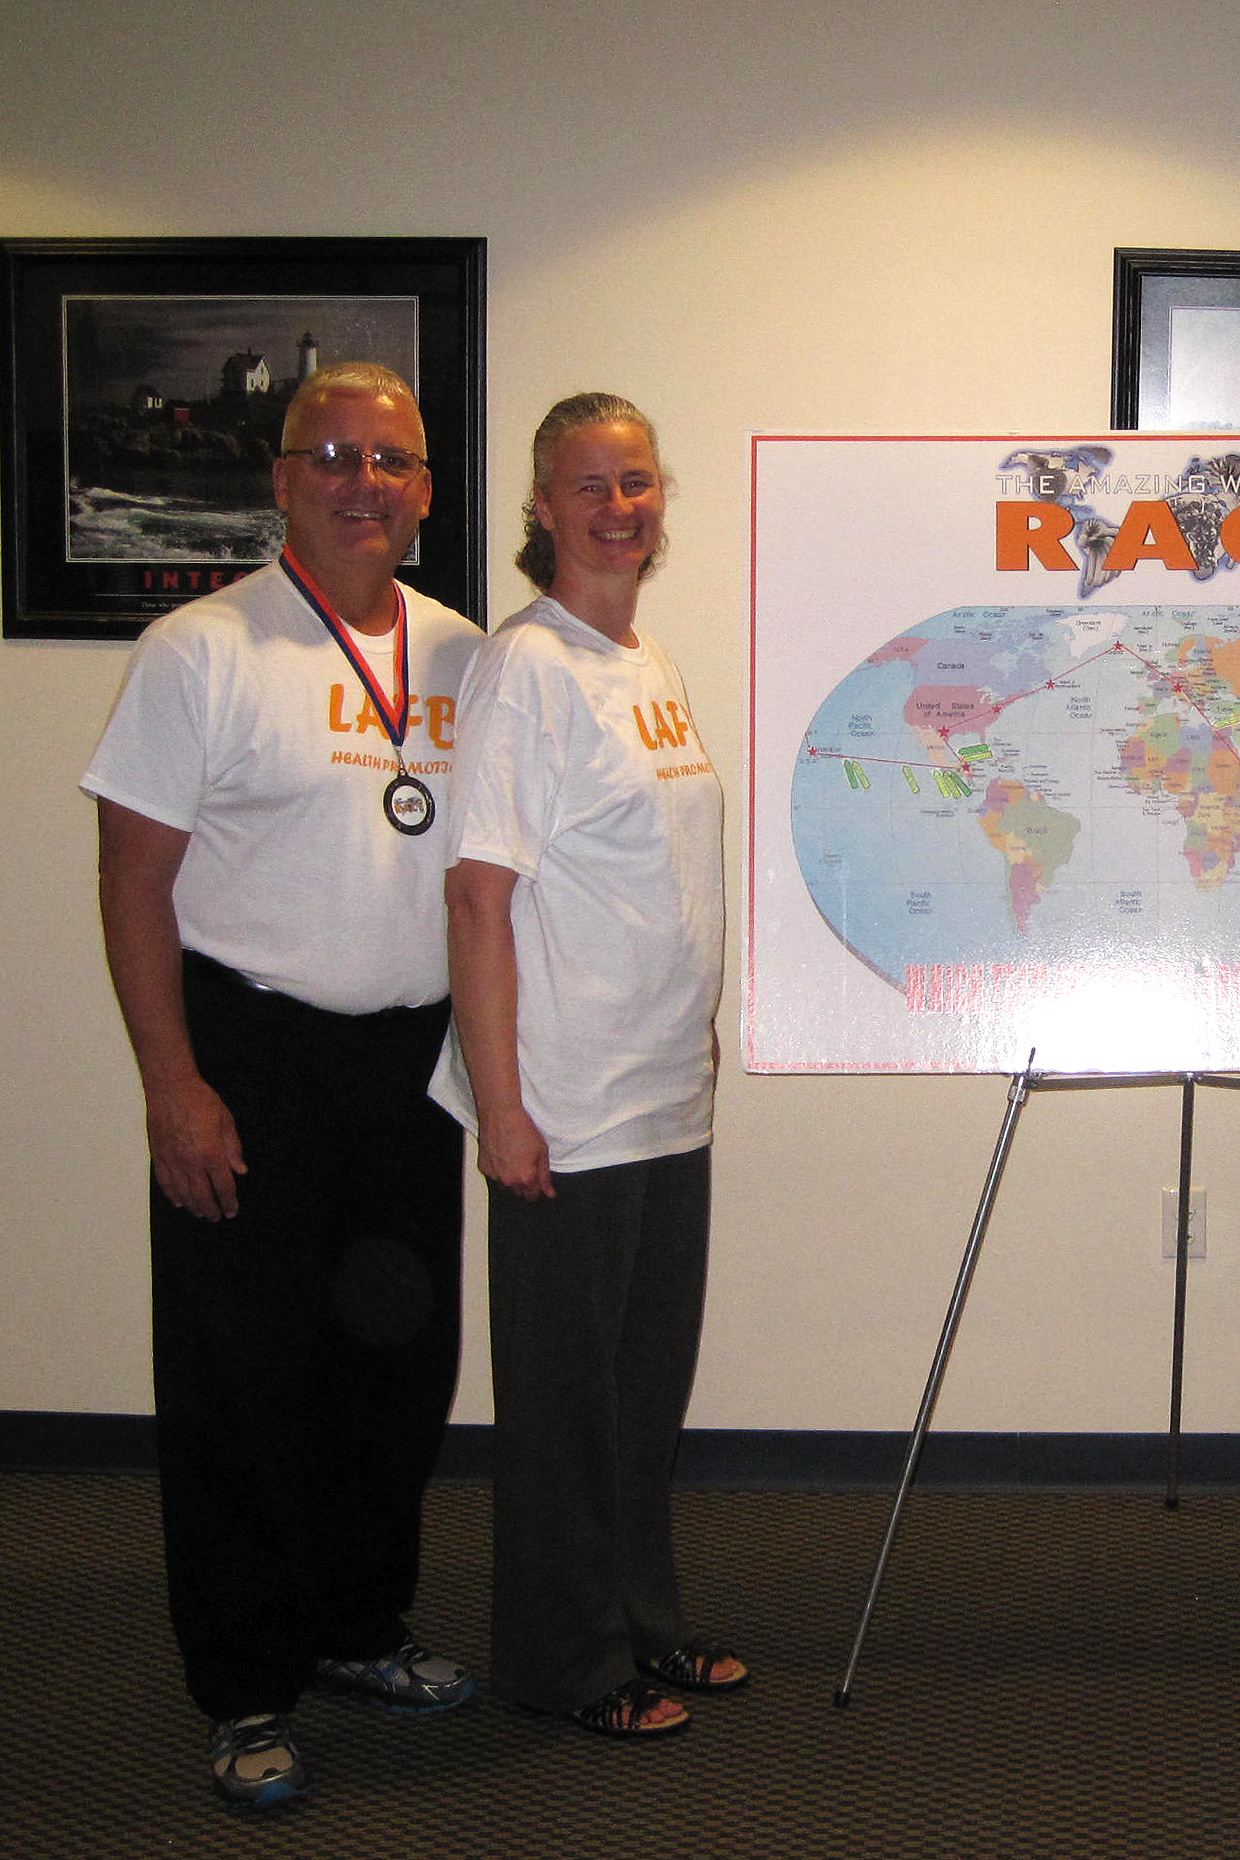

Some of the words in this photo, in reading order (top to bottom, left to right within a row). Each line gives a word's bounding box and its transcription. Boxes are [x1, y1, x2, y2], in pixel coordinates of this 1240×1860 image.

[995, 474, 1055, 494] THE
[1069, 474, 1206, 495] AMAZING
[144, 571, 249, 589] INTE
